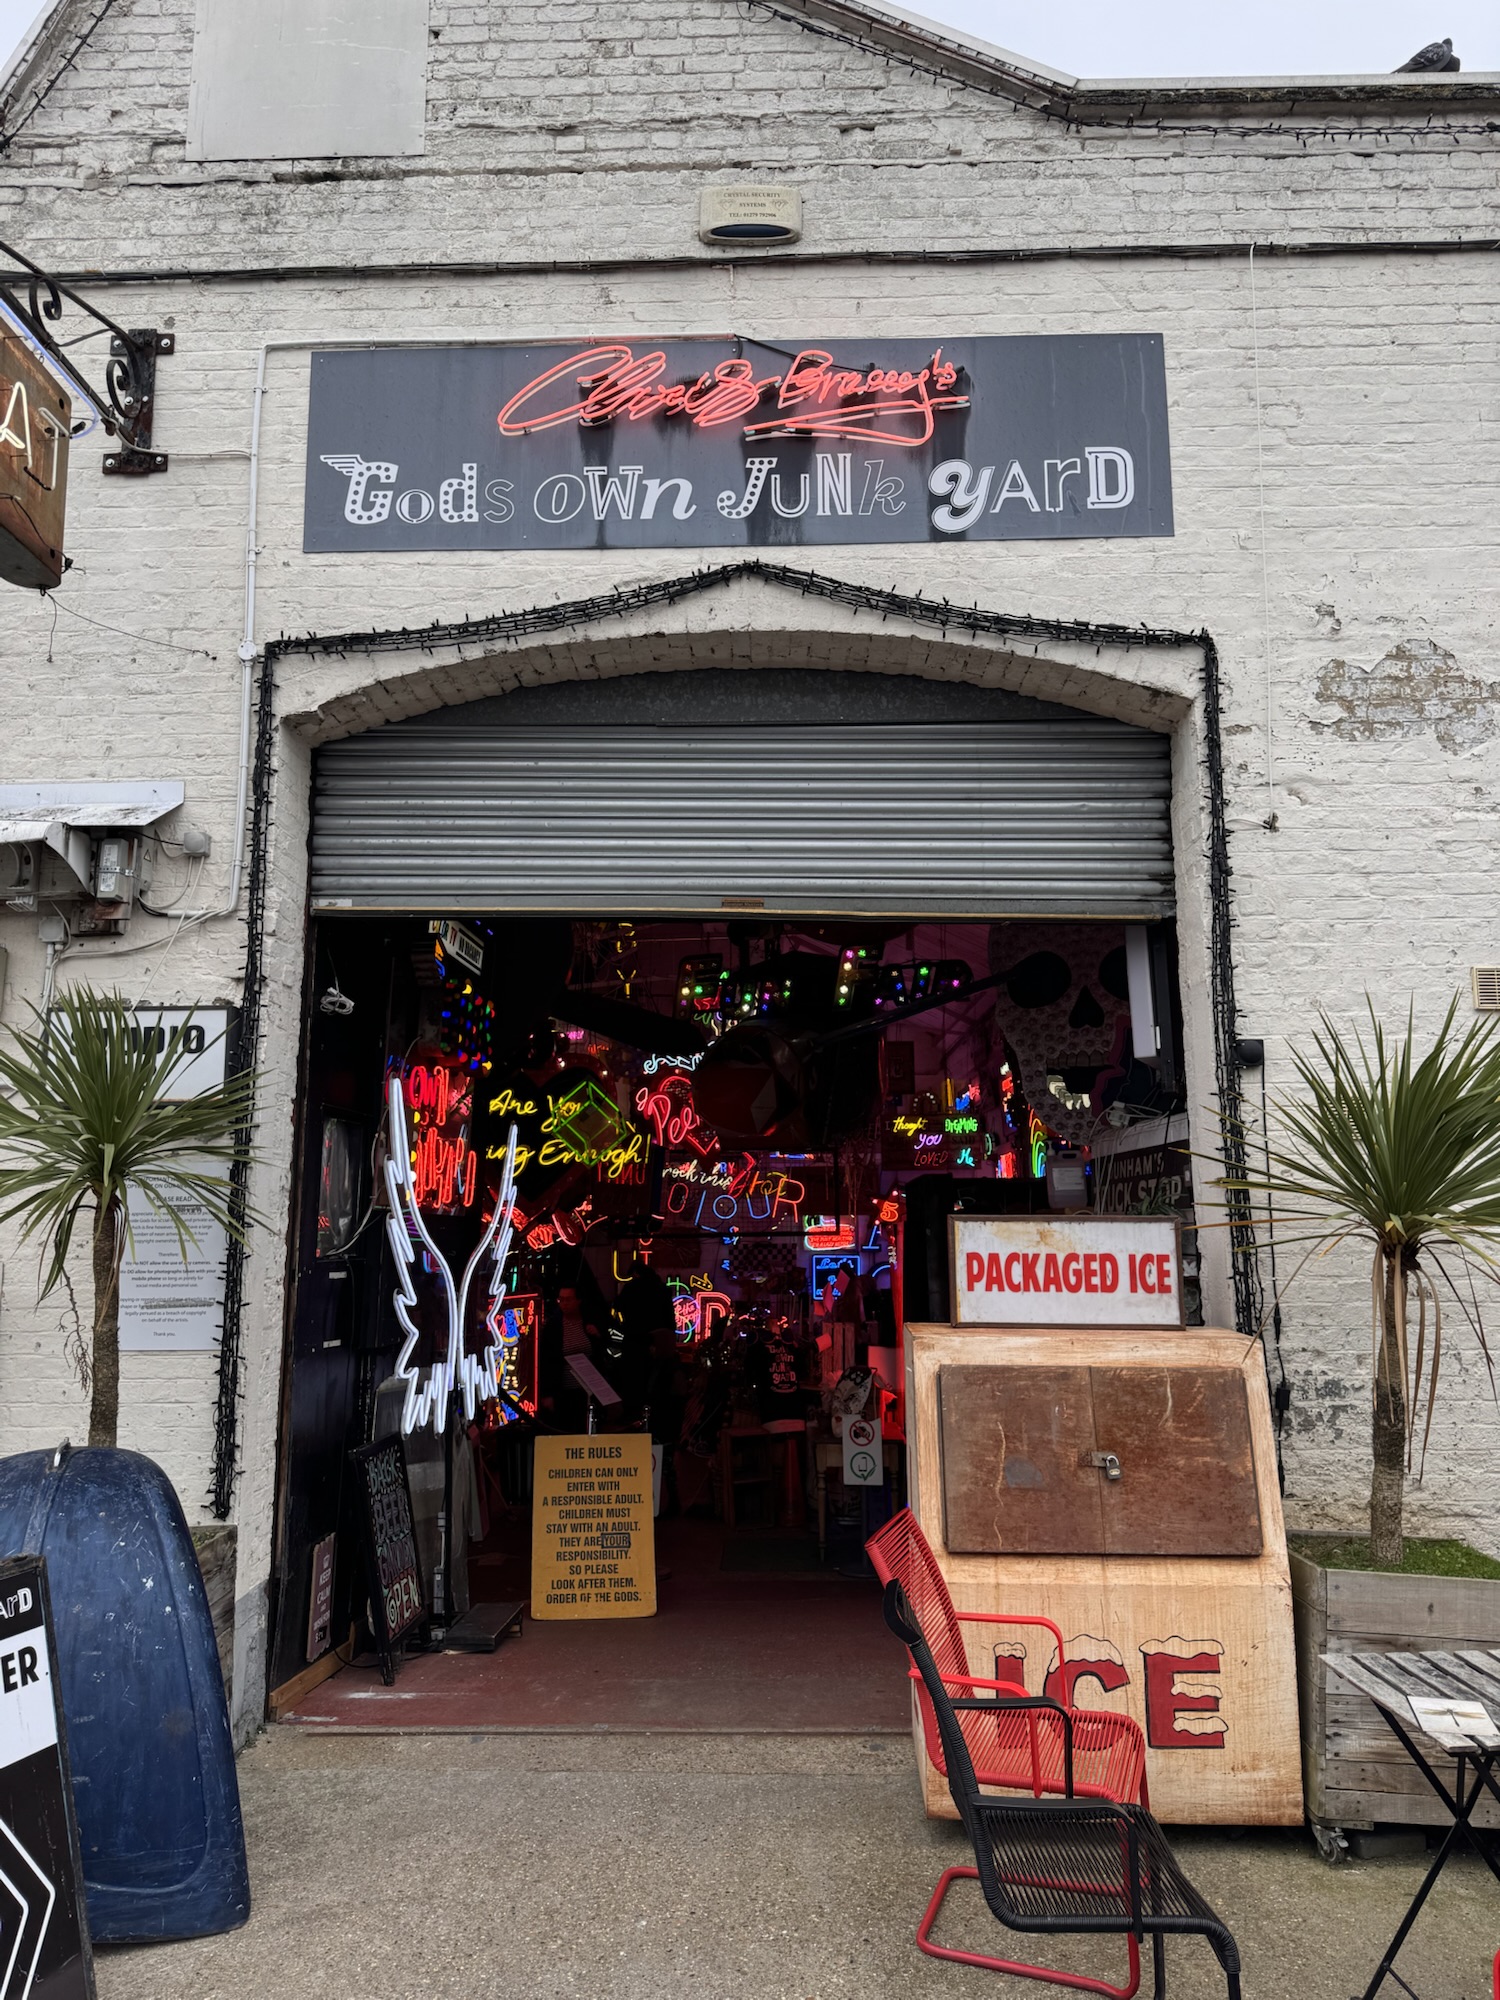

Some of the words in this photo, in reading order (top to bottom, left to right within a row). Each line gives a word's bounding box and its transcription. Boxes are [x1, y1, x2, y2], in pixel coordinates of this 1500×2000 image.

[70, 1024, 206, 1056] UDIO
[489, 1089, 538, 1116] Are
[965, 1251, 1120, 1294] PACKAGED
[1128, 1253, 1172, 1294] ICE
[565, 1448, 584, 1459] THE
[588, 1446, 622, 1459] RULES
[369, 1452, 399, 1495] BACK
[548, 1468, 592, 1479] CHILDREN
[595, 1467, 613, 1478] CAN
[616, 1467, 639, 1478] ONLY
[567, 1481, 595, 1492] ENTER
[597, 1481, 620, 1491] WITH
[542, 1496, 549, 1507] A
[551, 1495, 613, 1506] RESPONSIBLE
[615, 1493, 644, 1504] ADULT.
[559, 1509, 603, 1520] CHILDREN
[606, 1507, 631, 1518] MUST
[546, 1523, 567, 1534] STAY
[570, 1522, 593, 1533] WITH
[596, 1522, 609, 1532] AN
[611, 1521, 641, 1532] ADULT.
[559, 1536, 581, 1547] THEY
[584, 1536, 602, 1546] ARE
[604, 1535, 628, 1546] YOUR
[556, 1550, 631, 1562] RESPONSIBILITY.
[569, 1565, 582, 1575] SO
[585, 1563, 619, 1575] PLEASE
[551, 1579, 575, 1590] LOOK
[578, 1578, 606, 1589] AFTER
[608, 1577, 637, 1588] THEM.
[386, 1573, 420, 1630] OPEN
[546, 1593, 577, 1604] ORDER
[580, 1592, 592, 1603] OF
[595, 1592, 611, 1602] THE
[614, 1591, 642, 1602] GODS.
[0, 1645, 40, 1695] ER
[993, 1633, 1229, 1752] ICE
